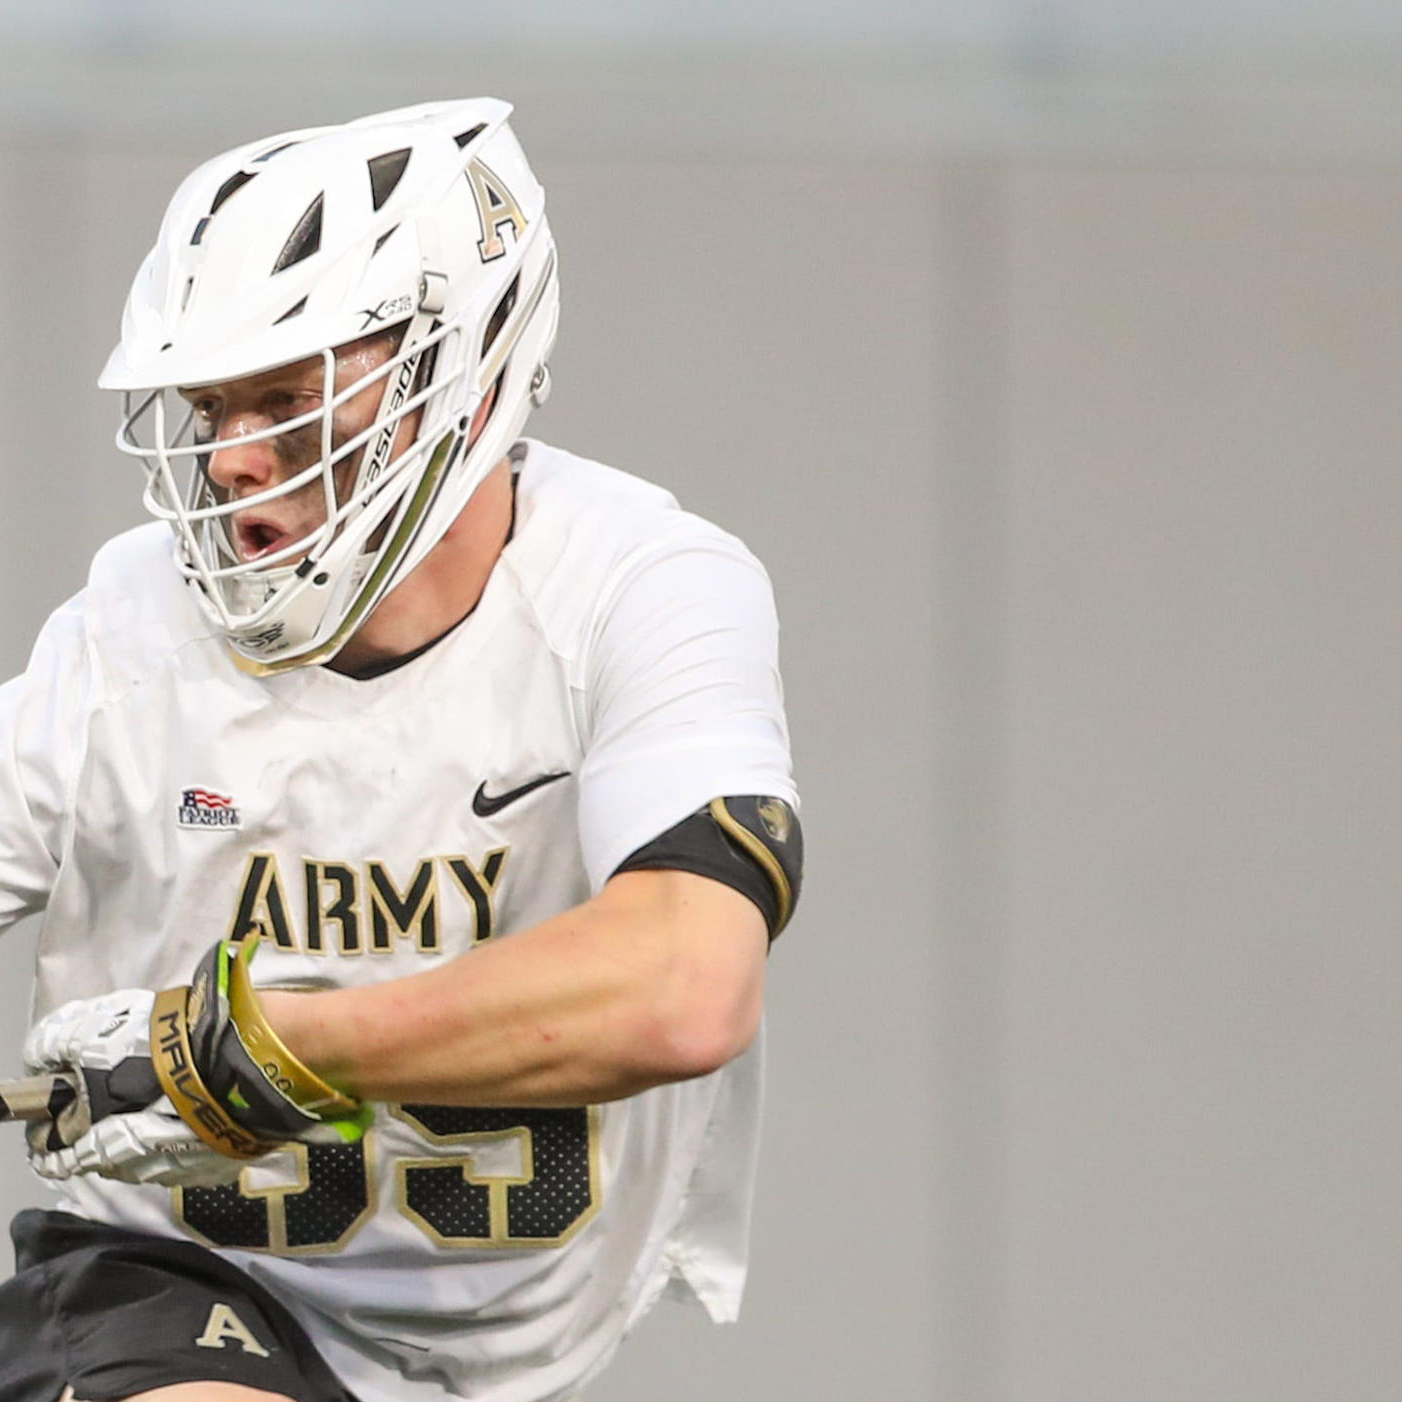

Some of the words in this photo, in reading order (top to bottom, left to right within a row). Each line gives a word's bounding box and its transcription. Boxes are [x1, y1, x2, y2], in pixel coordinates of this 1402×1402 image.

[464, 156, 530, 264] A
[227, 846, 511, 956] ARMY
[195, 1303, 270, 1358] A
